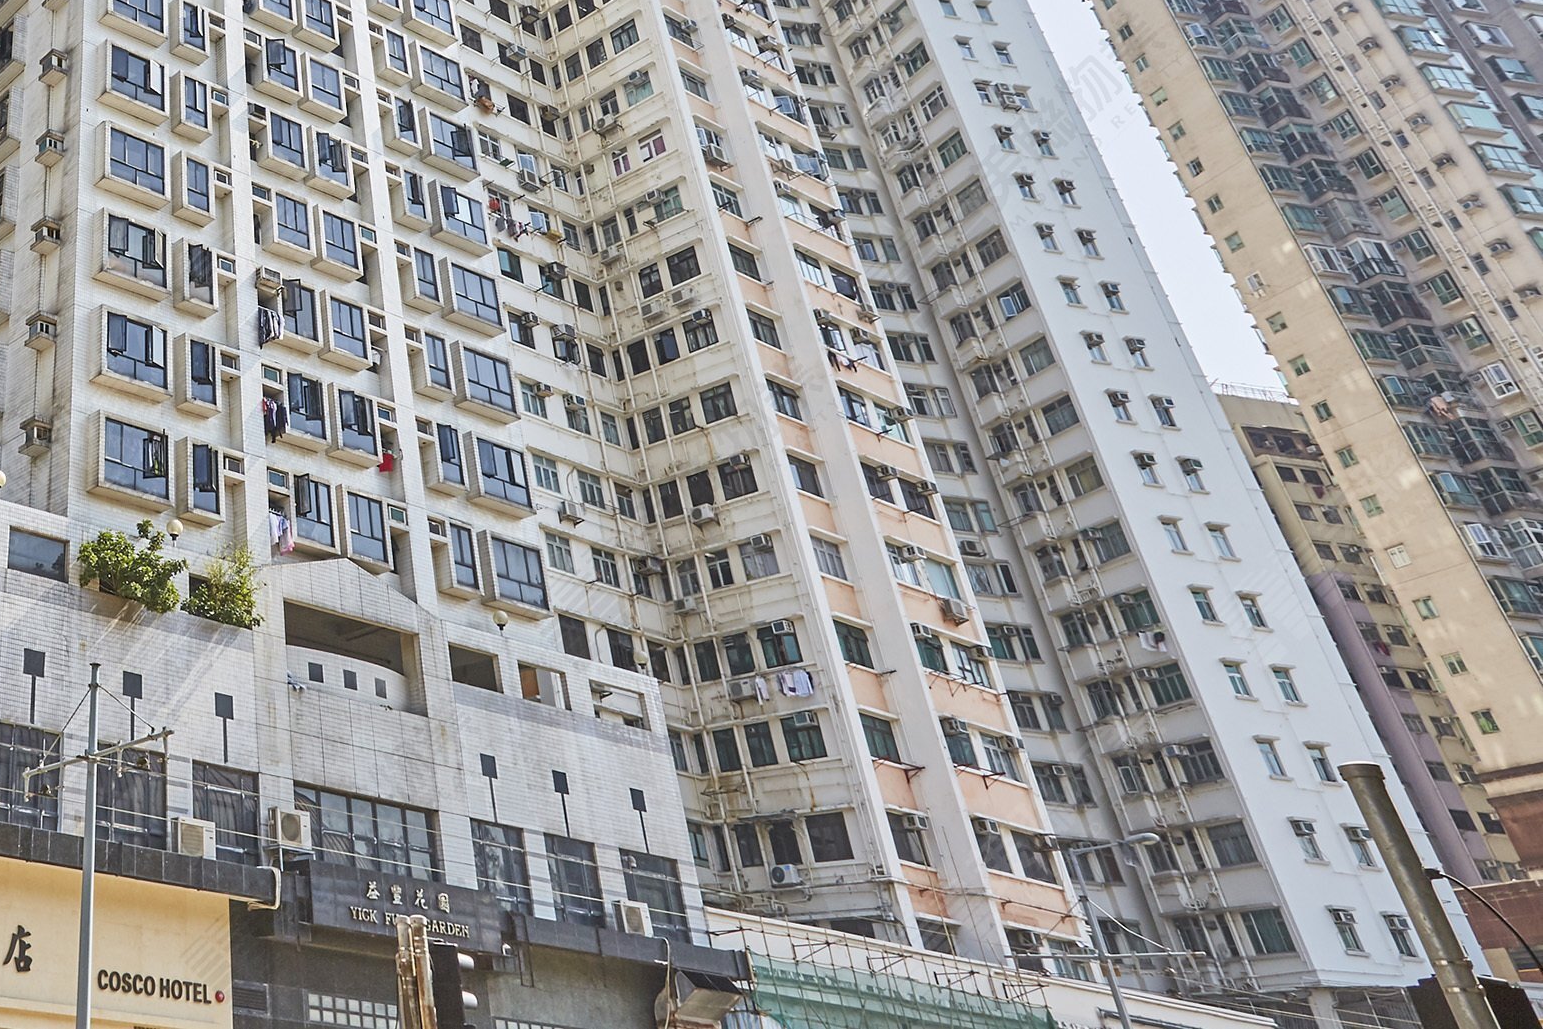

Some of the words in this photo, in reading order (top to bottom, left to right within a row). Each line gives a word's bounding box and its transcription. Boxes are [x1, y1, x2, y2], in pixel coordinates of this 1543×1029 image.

[350, 905, 378, 925] YICK
[426, 918, 470, 939] GARDEN
[97, 969, 156, 996] COSCO
[159, 977, 212, 1004] HOTEL
